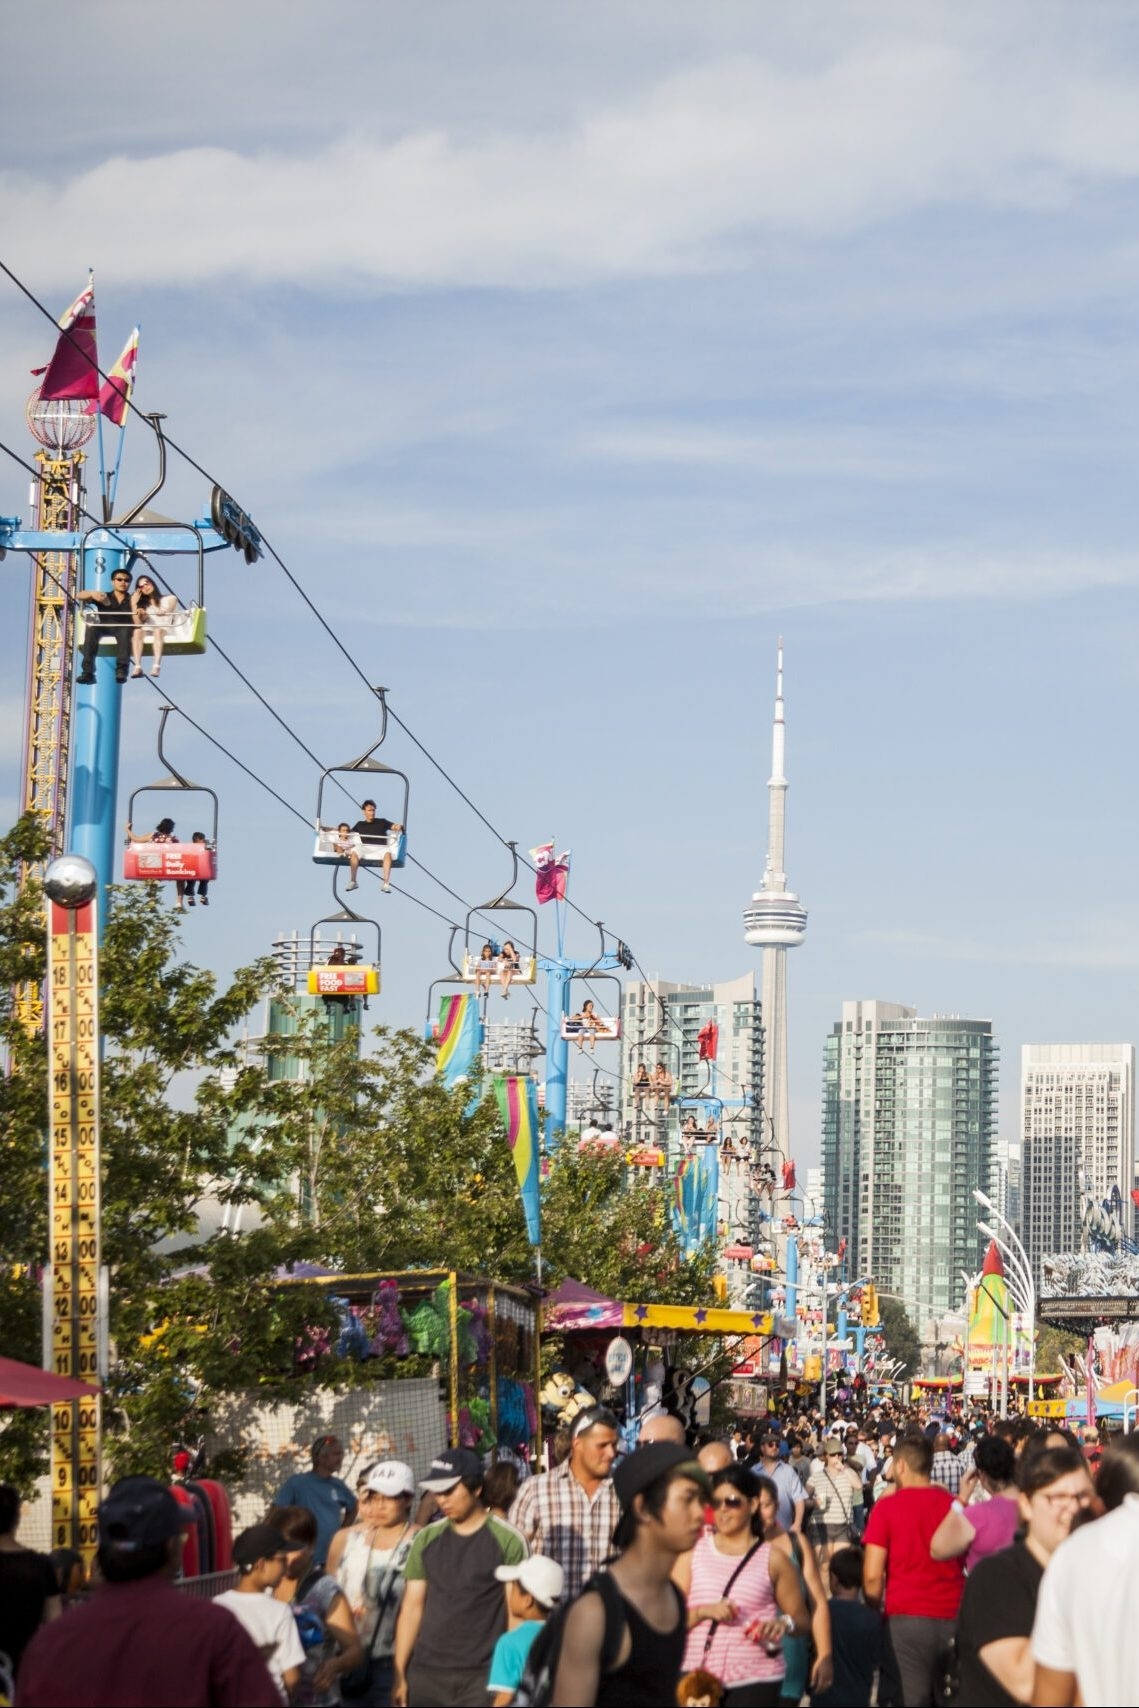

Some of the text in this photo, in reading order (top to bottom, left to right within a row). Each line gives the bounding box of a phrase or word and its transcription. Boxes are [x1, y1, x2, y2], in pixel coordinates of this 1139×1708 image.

[95, 557, 106, 574] 8
[166, 861, 184, 869] Daily
[53, 964, 94, 985] 18 00
[54, 1018, 94, 1039] 17 00
[54, 1072, 95, 1092] 16 00
[54, 1126, 95, 1147] 15 00
[54, 1182, 95, 1202] 14 00
[54, 1239, 96, 1261] 13 00
[54, 1295, 97, 1317] 12 00
[56, 1352, 97, 1374] 11 00
[54, 1409, 97, 1430] 10 00
[58, 1466, 97, 1487] 9 00
[58, 1524, 97, 1546] 8 00
